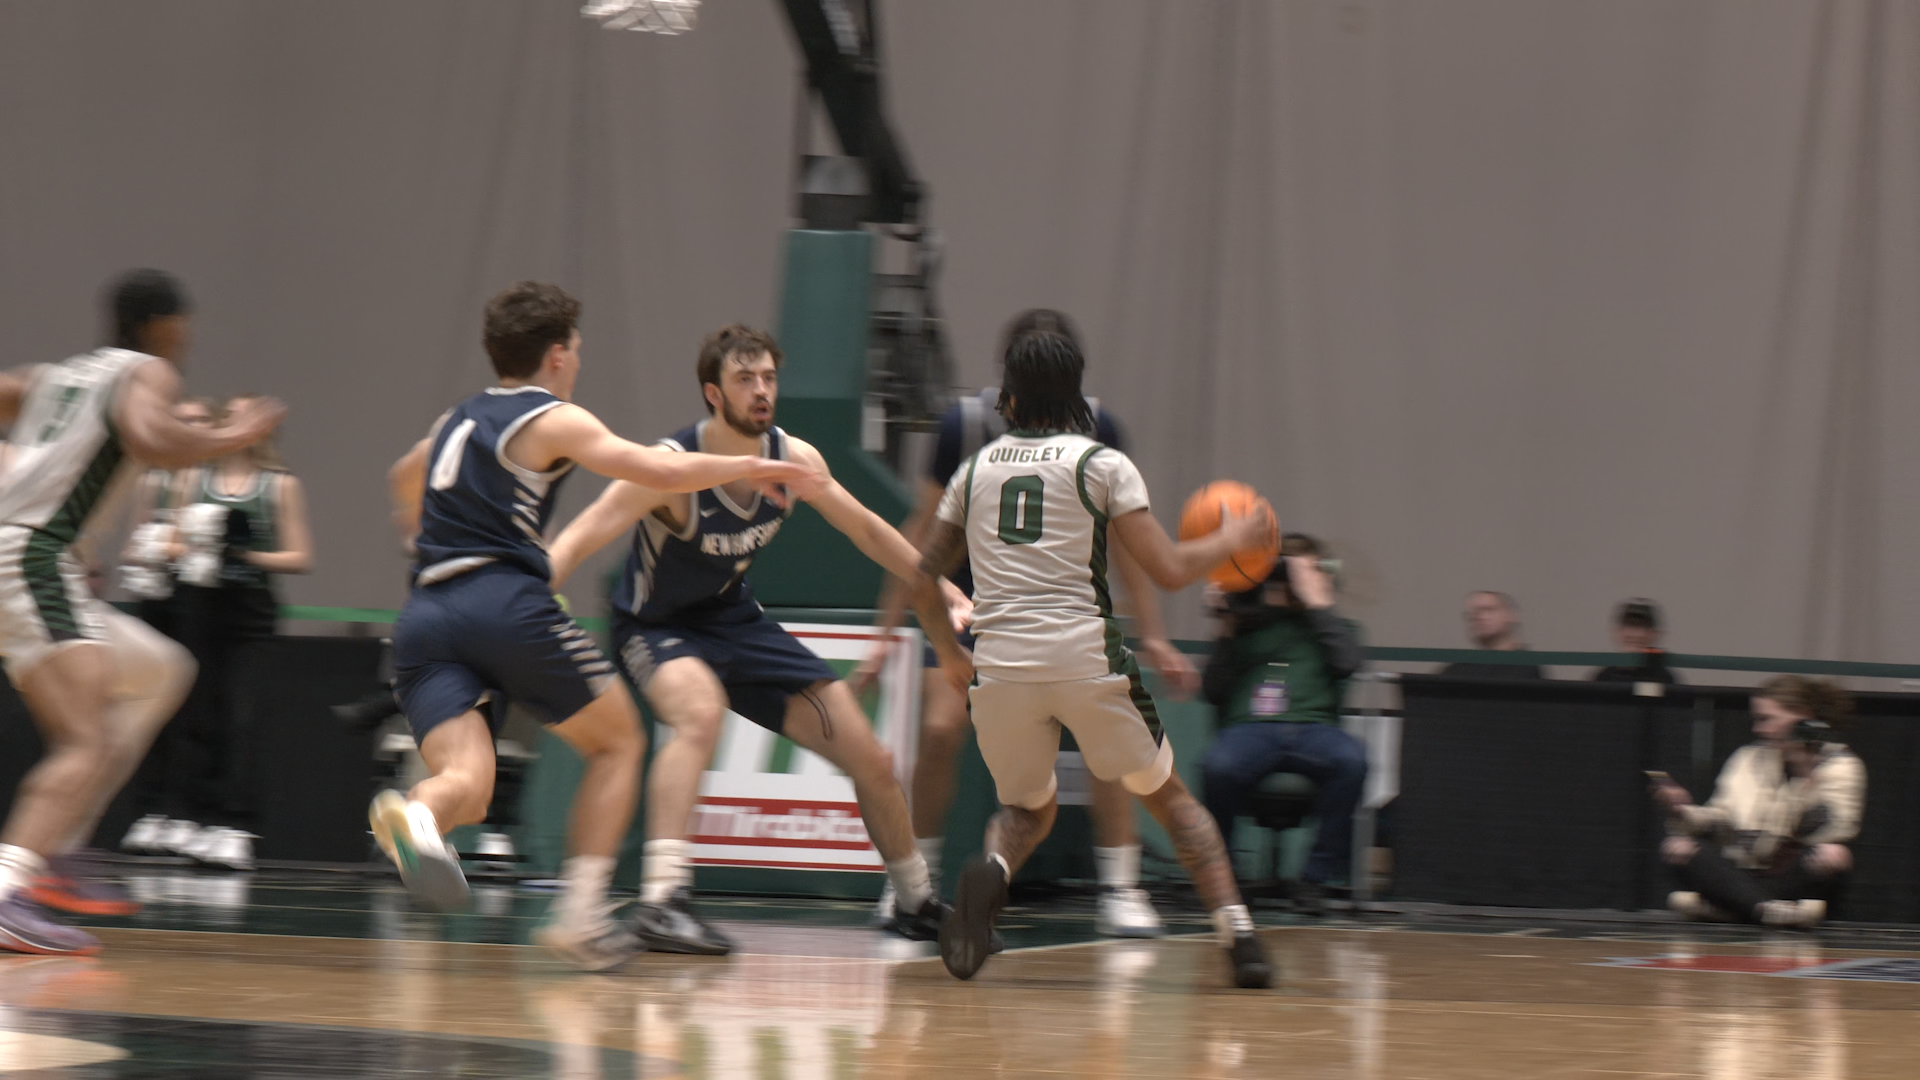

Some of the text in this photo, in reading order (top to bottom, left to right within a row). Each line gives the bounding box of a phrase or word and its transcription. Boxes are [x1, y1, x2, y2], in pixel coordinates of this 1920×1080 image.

[988, 446, 1066, 463] QUIGLEY
[998, 475, 1044, 545] 0
[701, 533, 731, 556] NEW
